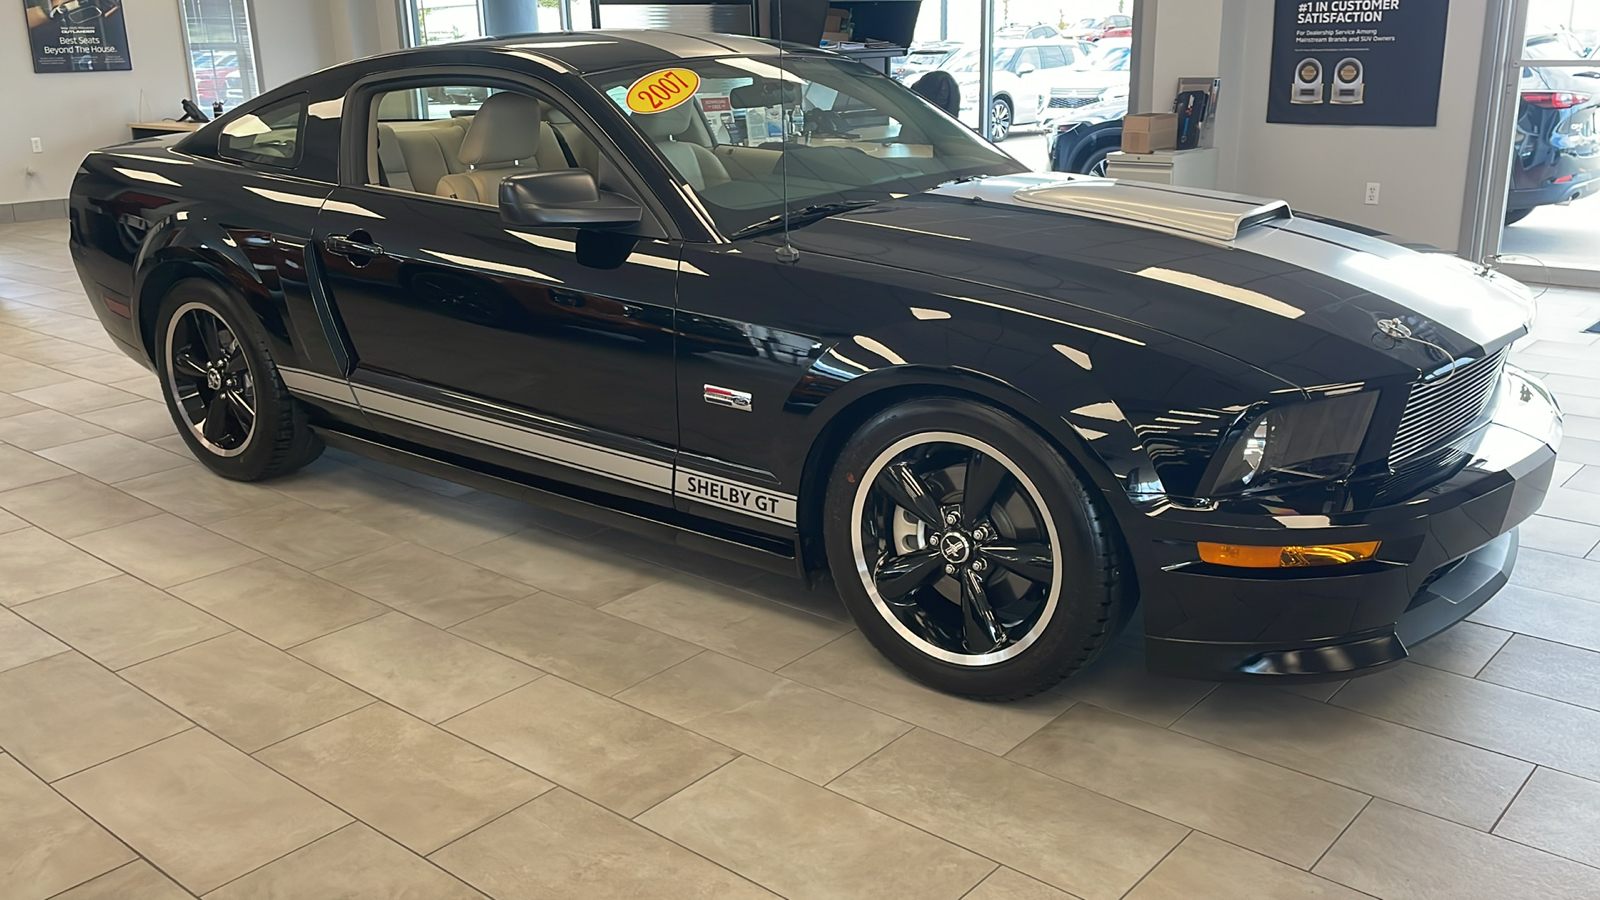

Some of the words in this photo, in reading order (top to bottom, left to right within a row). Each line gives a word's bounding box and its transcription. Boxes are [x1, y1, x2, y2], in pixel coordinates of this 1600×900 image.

[1299, 2, 1313, 12] #1
[1315, 2, 1328, 12] IN
[1331, 0, 1399, 12] CUSTOMER
[1297, 11, 1382, 24] SATISFACTION
[44, 46, 74, 55] Beyond
[638, 71, 689, 109] 2007
[687, 476, 751, 507] SHELBY
[755, 495, 780, 514] GT
